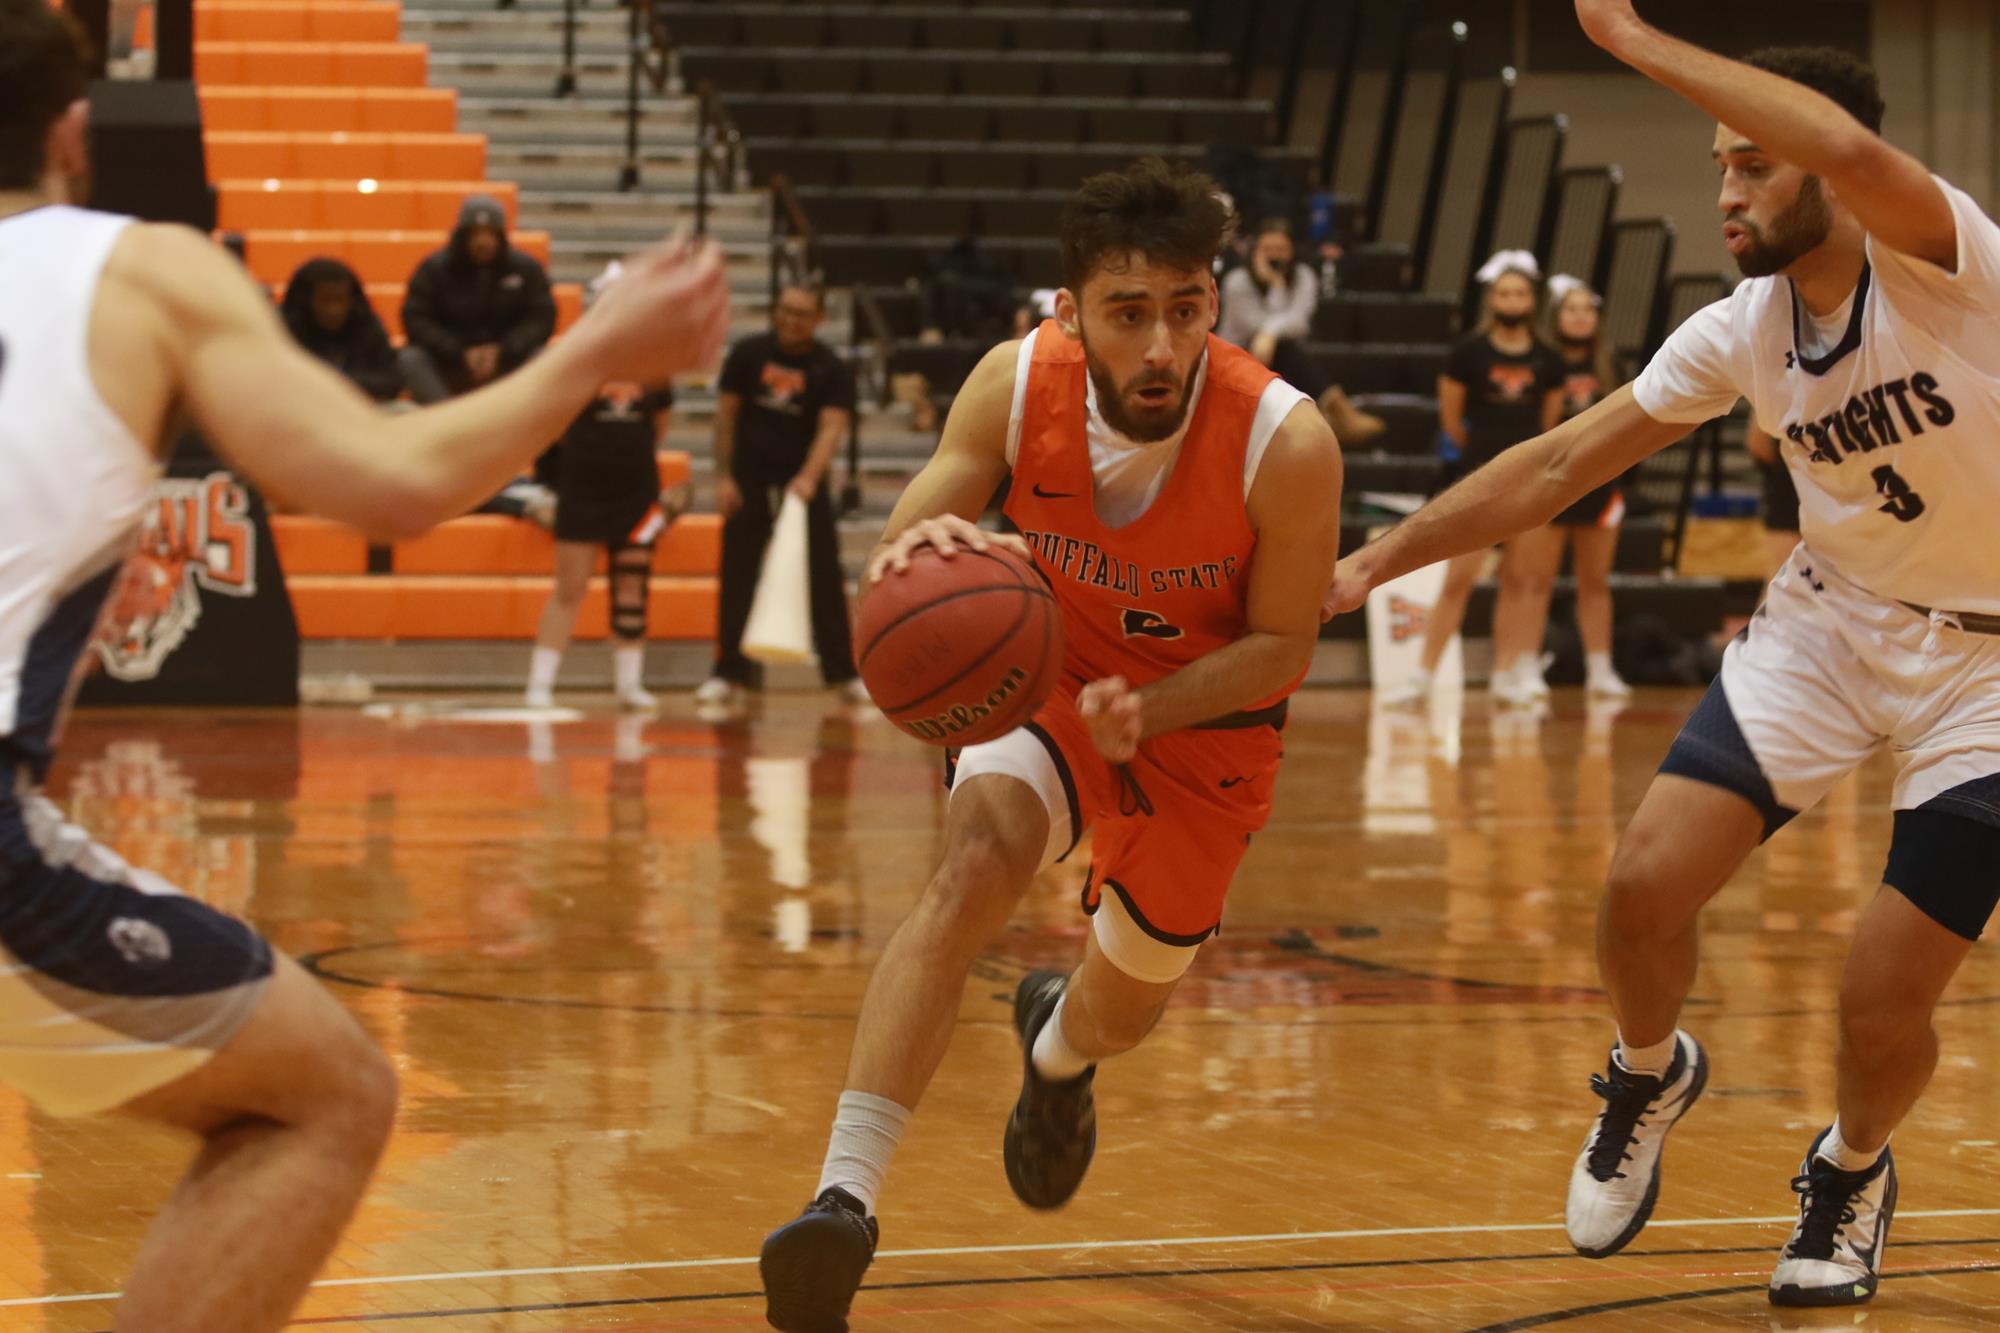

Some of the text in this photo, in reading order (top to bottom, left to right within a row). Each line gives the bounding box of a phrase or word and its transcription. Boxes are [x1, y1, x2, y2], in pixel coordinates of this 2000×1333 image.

[1871, 464, 1926, 522] 3
[1149, 554, 1240, 594] STATE
[901, 665, 1029, 741] Wilson
